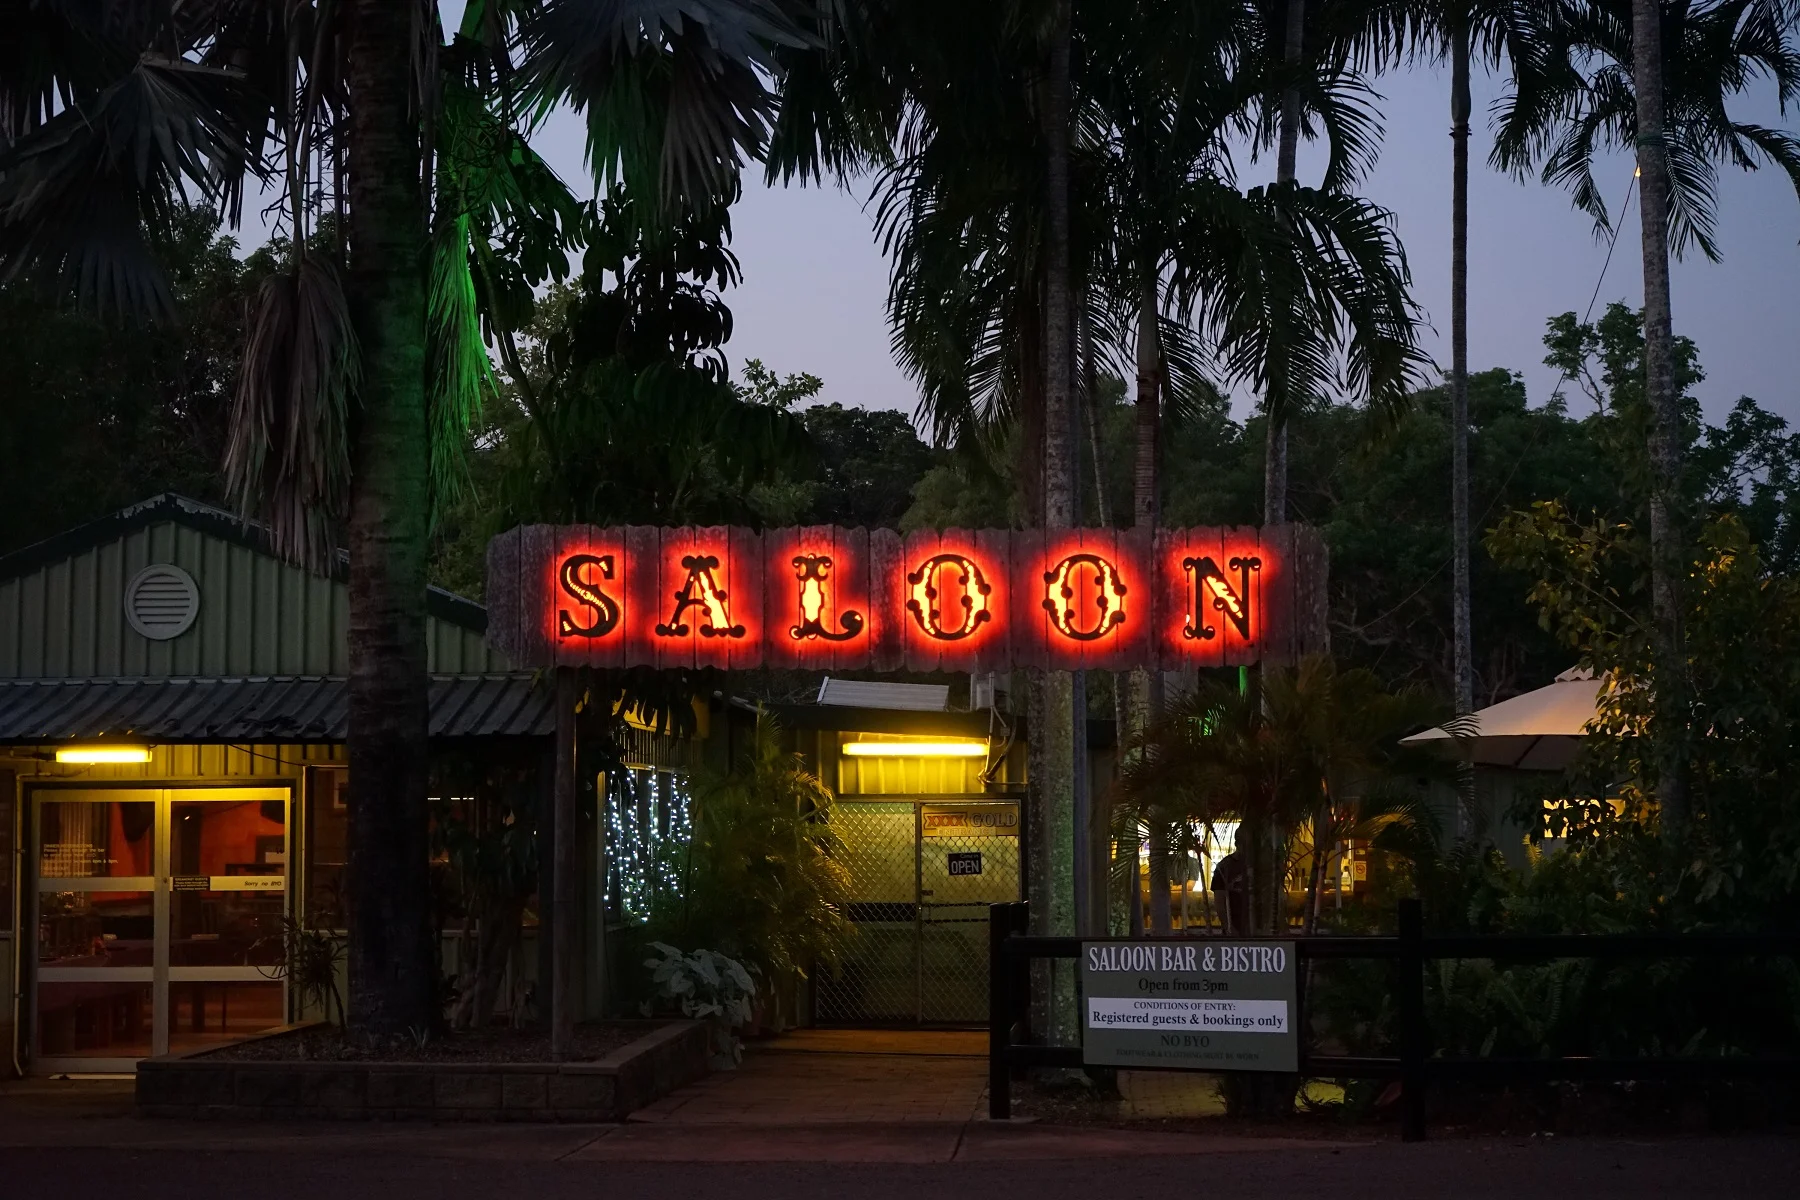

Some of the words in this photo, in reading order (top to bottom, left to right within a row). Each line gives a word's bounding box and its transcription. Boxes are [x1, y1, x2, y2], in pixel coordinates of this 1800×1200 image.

[559, 554, 1261, 640] SALOON
[927, 816, 964, 827] XXXX
[970, 812, 1018, 827] GOLD
[951, 860, 979, 874] OPEN
[1089, 946, 1156, 972] SALOON
[1161, 946, 1197, 972] BAR
[1202, 946, 1216, 972] &
[1220, 946, 1286, 973] BISTRO
[1138, 978, 1169, 993] Open
[1173, 978, 1200, 991] from
[1202, 979, 1229, 994] 3pm
[1134, 1001, 1189, 1010] CONDITIONS
[1190, 1002, 1203, 1010] OF
[1204, 1002, 1236, 1011] ENTRY:
[1093, 1011, 1149, 1025] Registered
[1152, 1014, 1187, 1026] guests
[1190, 1014, 1200, 1025] &
[1203, 1014, 1255, 1028] bookings
[1258, 1015, 1284, 1028] only
[1160, 1034, 1180, 1046] NO
[1184, 1035, 1210, 1047] BYO
